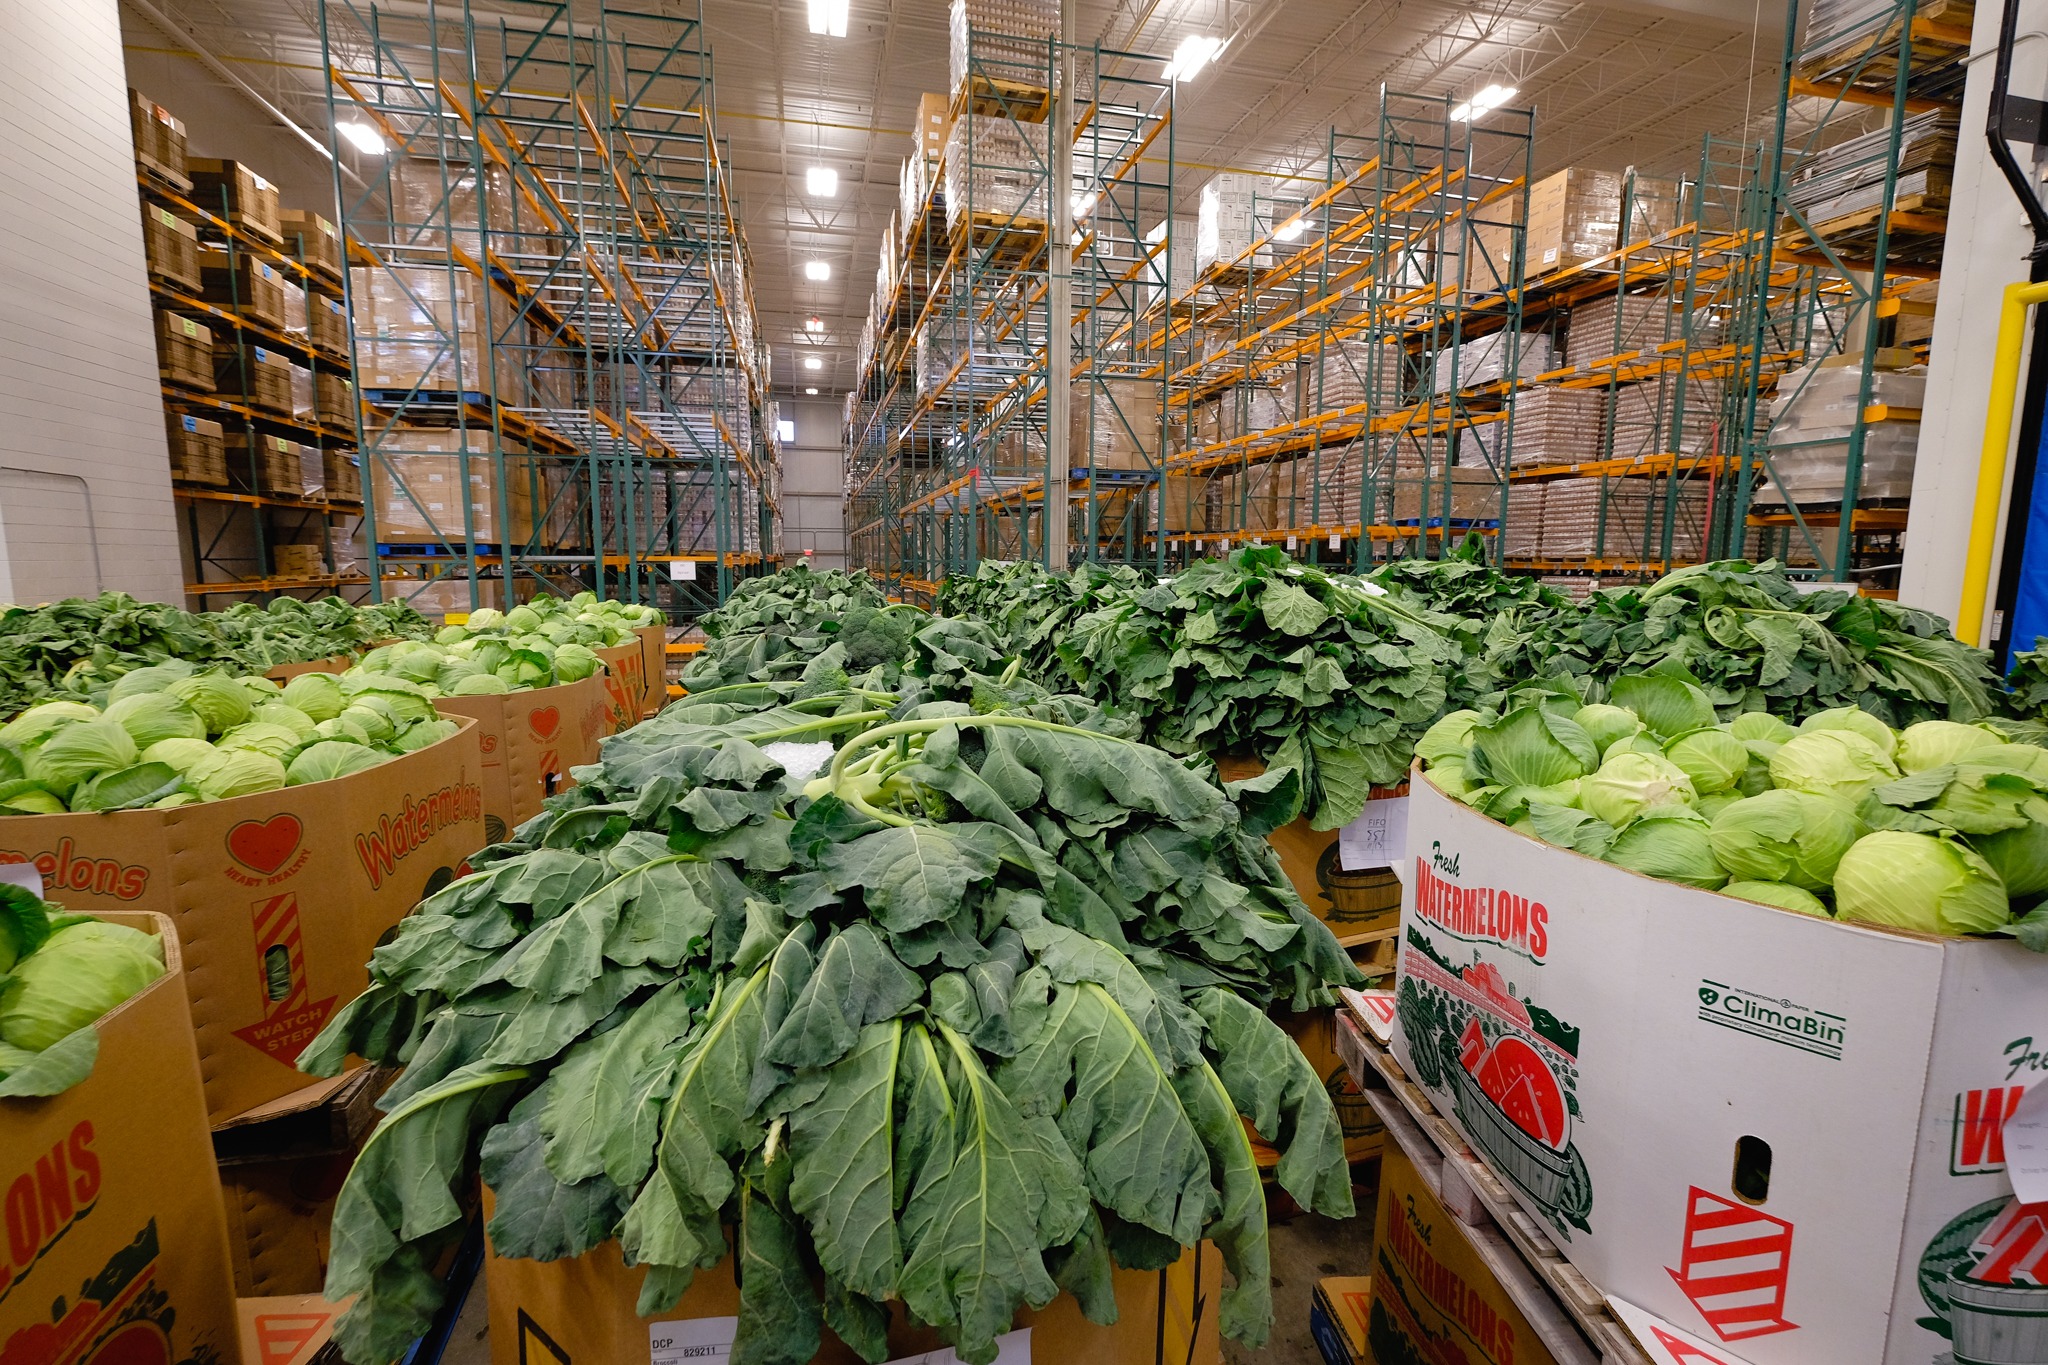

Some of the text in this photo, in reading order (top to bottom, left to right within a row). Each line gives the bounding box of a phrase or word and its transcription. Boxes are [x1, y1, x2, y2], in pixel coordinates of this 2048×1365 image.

[355, 765, 480, 891] Watermelons
[1368, 818, 1387, 827] FIFO
[224, 849, 312, 887] HEART HEALTHY
[1432, 841, 1460, 877] Fresh
[1416, 855, 1548, 957] WATERMELONS
[1734, 988, 1809, 1012] INTERNATIONAL PAPER
[253, 1008, 322, 1040] WATCH
[1723, 995, 1844, 1044] ClimaBin
[267, 1027, 314, 1051] STEP
[0, 1119, 101, 1290] ONS
[1407, 1194, 1432, 1246] Fresh
[1390, 1190, 1515, 1365] WATERMELONS
[652, 1339, 673, 1349] DCP
[684, 1347, 716, 1357] 829211
